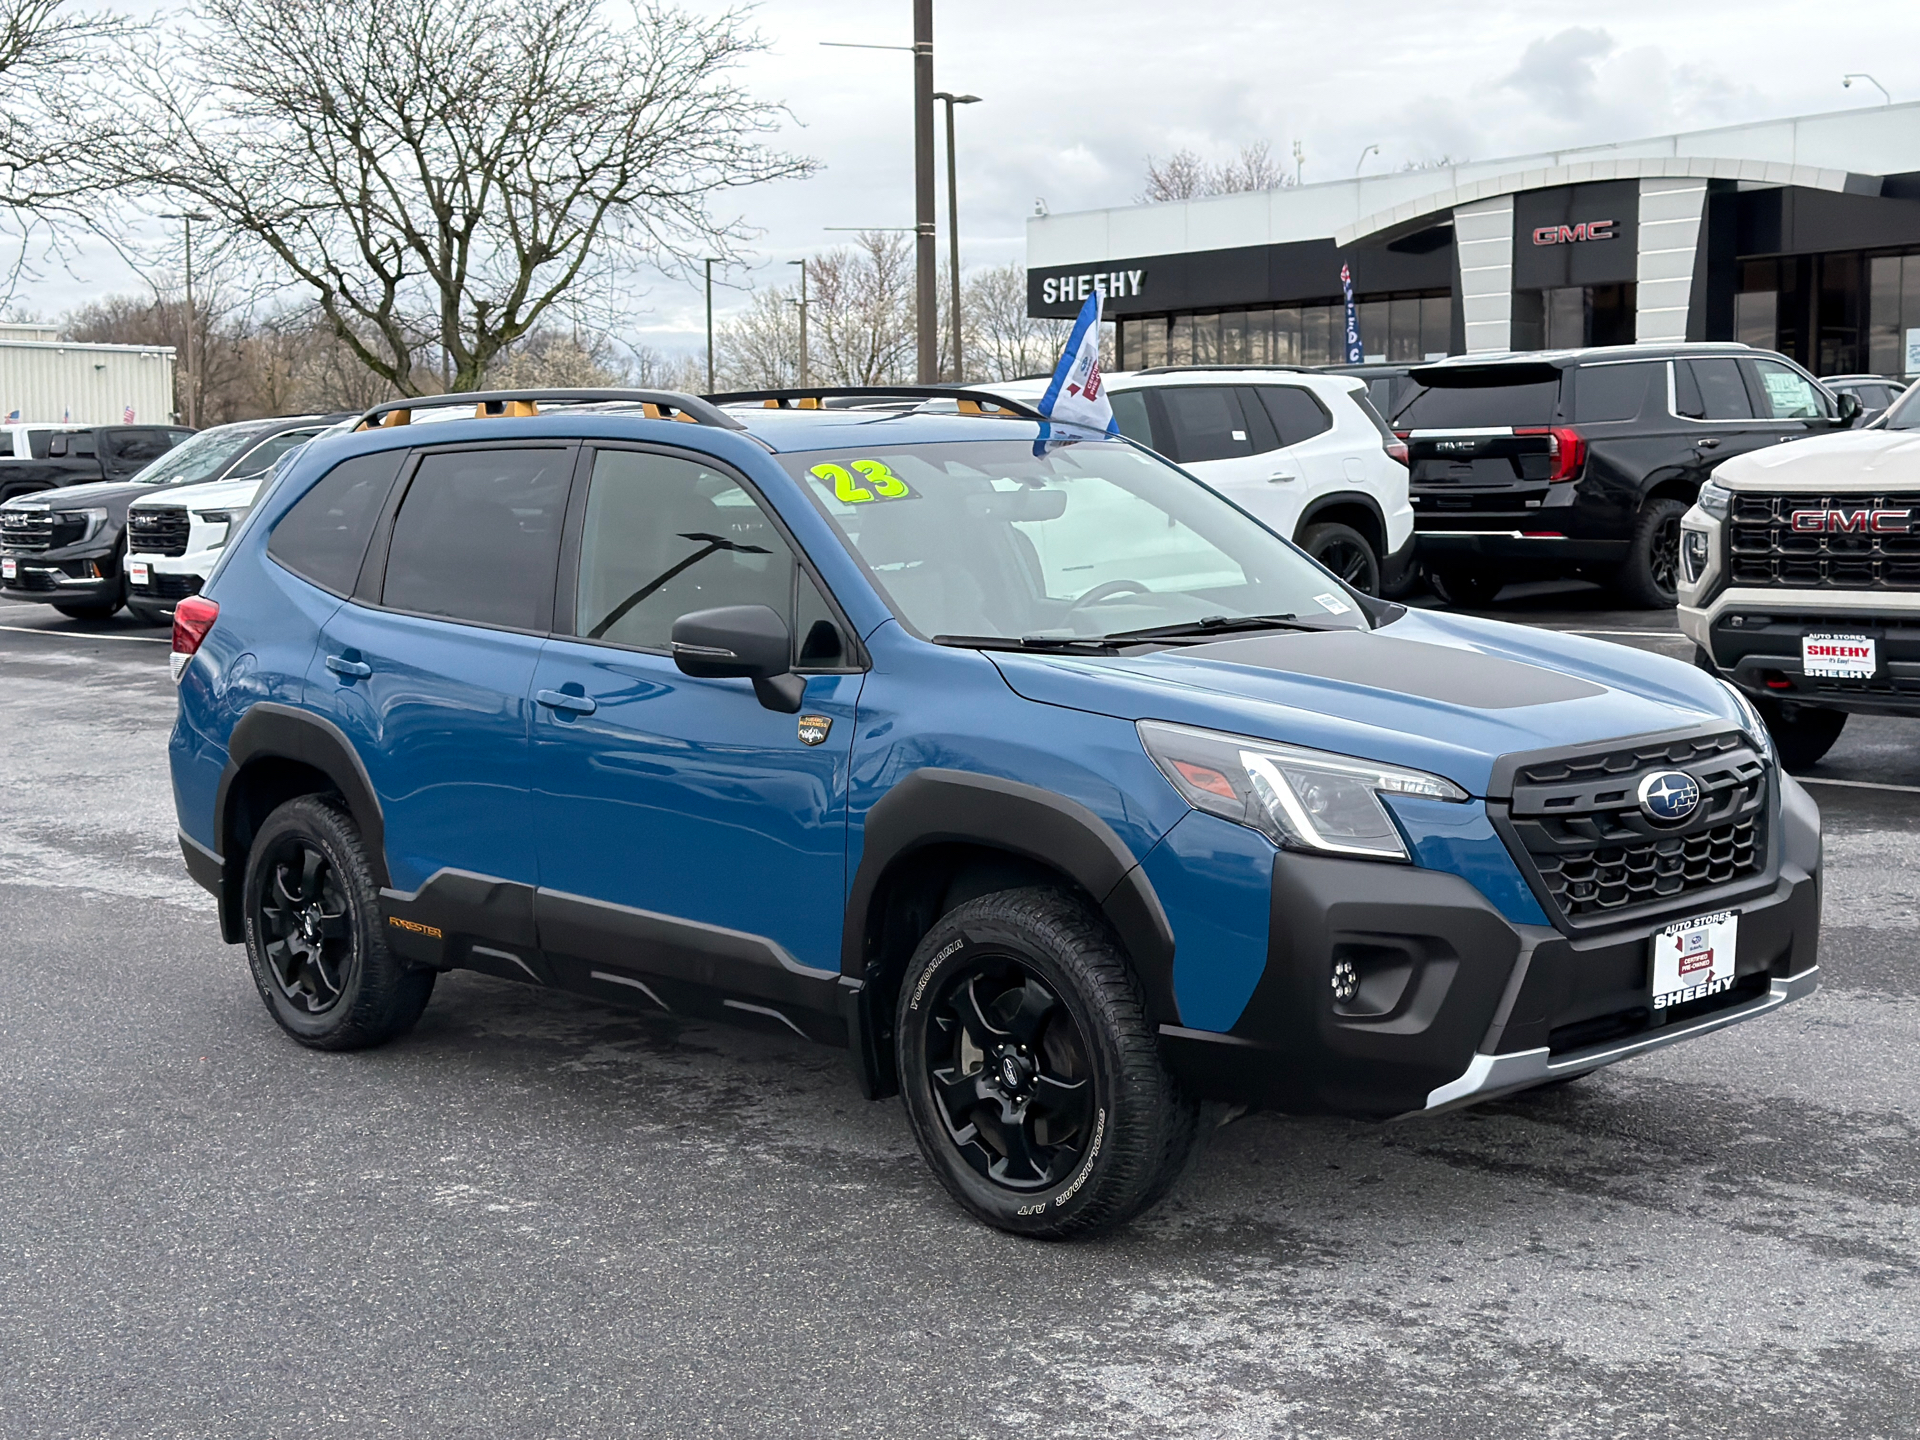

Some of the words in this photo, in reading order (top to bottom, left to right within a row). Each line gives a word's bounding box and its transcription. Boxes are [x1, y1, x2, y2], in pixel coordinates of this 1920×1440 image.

[1533, 220, 1613, 246] GMC
[1042, 270, 1143, 304] SHEEHY
[810, 459, 909, 503] 23
[1791, 509, 1912, 533] GMC
[1807, 645, 1870, 658] SHEEHY
[1804, 669, 1874, 680] SHEEHY
[389, 916, 442, 939] FORESTER
[1665, 921, 1692, 935] AUTO
[1693, 911, 1731, 927] STORES
[910, 938, 963, 1011] YOKOHAMA
[1654, 976, 1735, 1010] SHEEHY
[1055, 1107, 1107, 1208] GEOLANDAR
[1017, 1203, 1047, 1218] A/T
